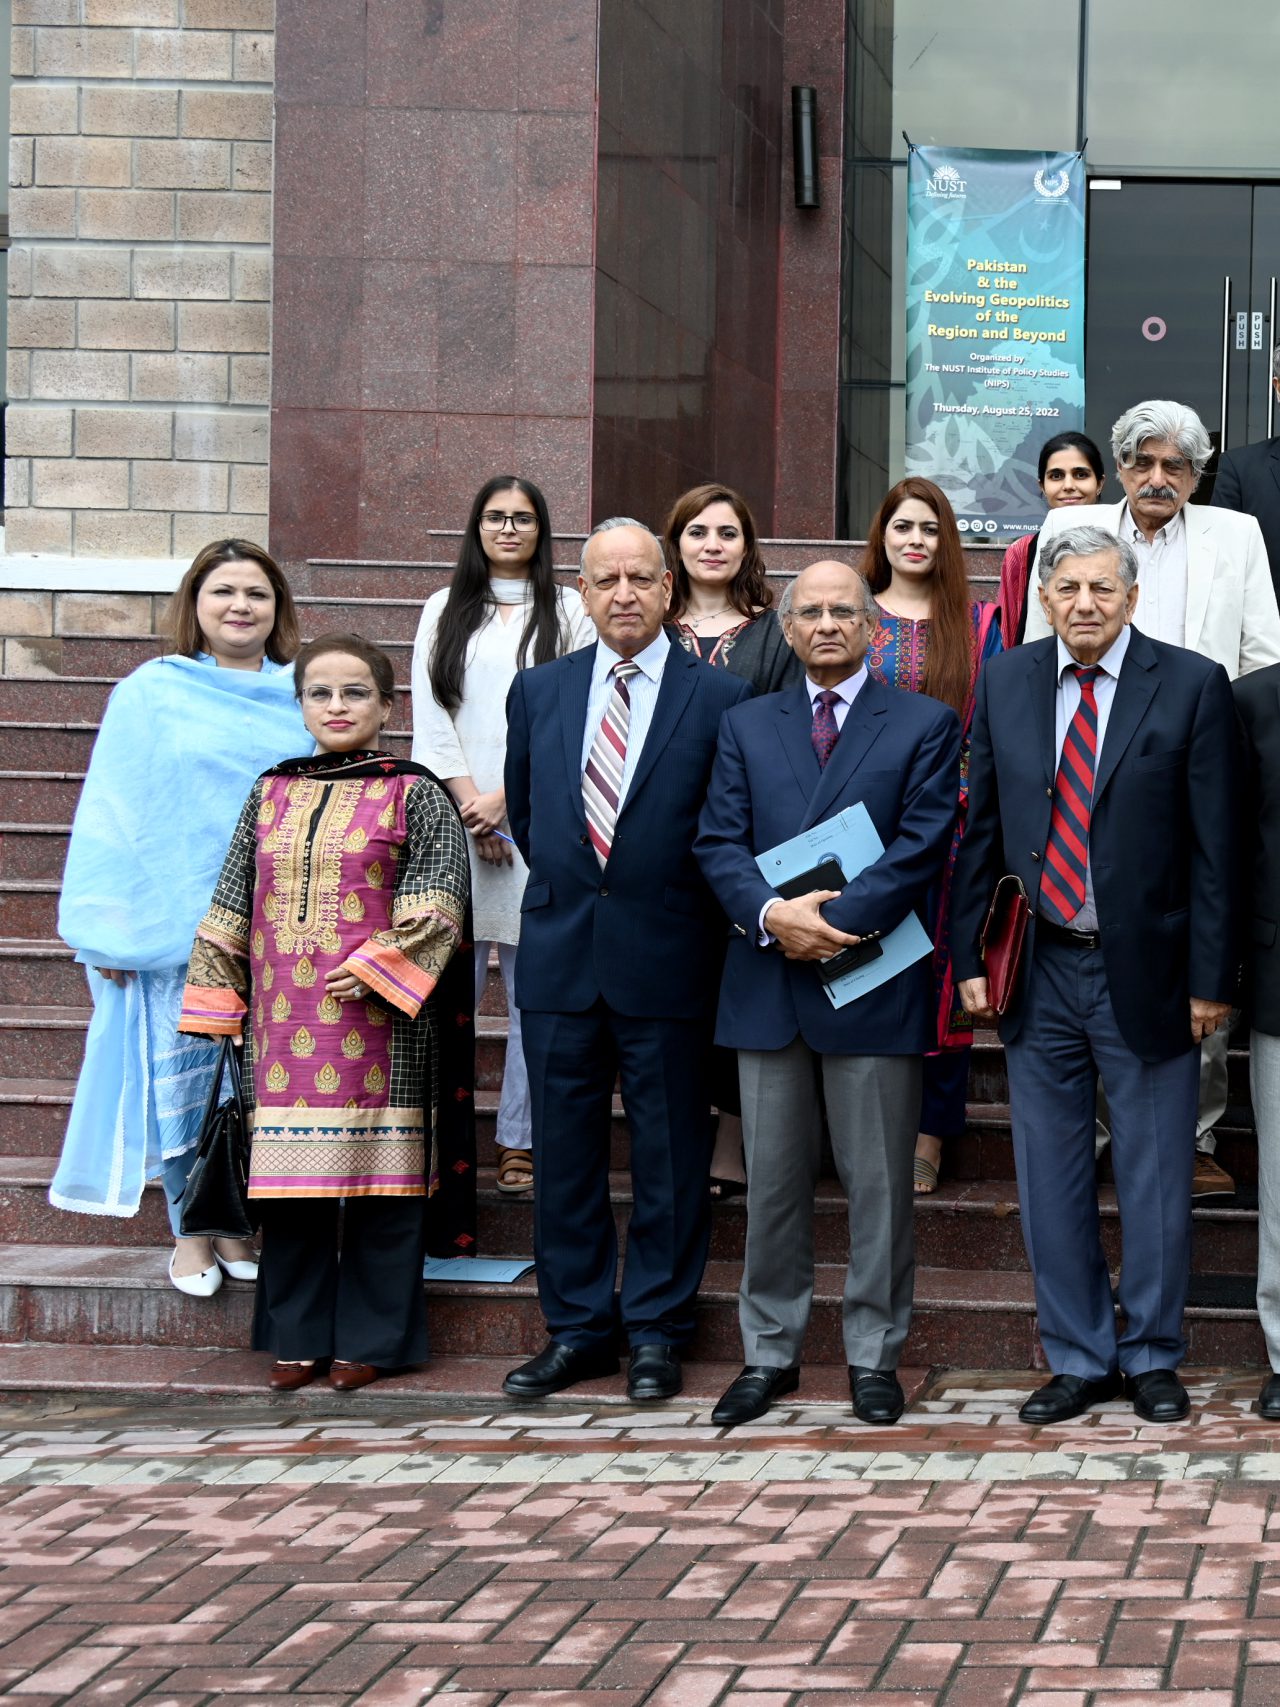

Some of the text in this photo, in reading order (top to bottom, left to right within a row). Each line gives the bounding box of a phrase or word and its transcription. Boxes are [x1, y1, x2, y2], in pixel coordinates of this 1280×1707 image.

[926, 179, 967, 192] NUST
[967, 259, 1027, 273] Pakistan
[977, 276, 1018, 289] & the
[924, 290, 1070, 309] Evolving Geopolitics
[976, 310, 1019, 323] of the
[927, 324, 1066, 344] Region and Beyond
[970, 353, 1024, 364] Organized by
[924, 363, 1069, 379] The NUST Institute of Policy Studies
[984, 379, 1010, 390] (NIPS)
[933, 402, 1060, 418] Thursday, August 25, 2022
[1002, 523, 1041, 531] www.nust.
